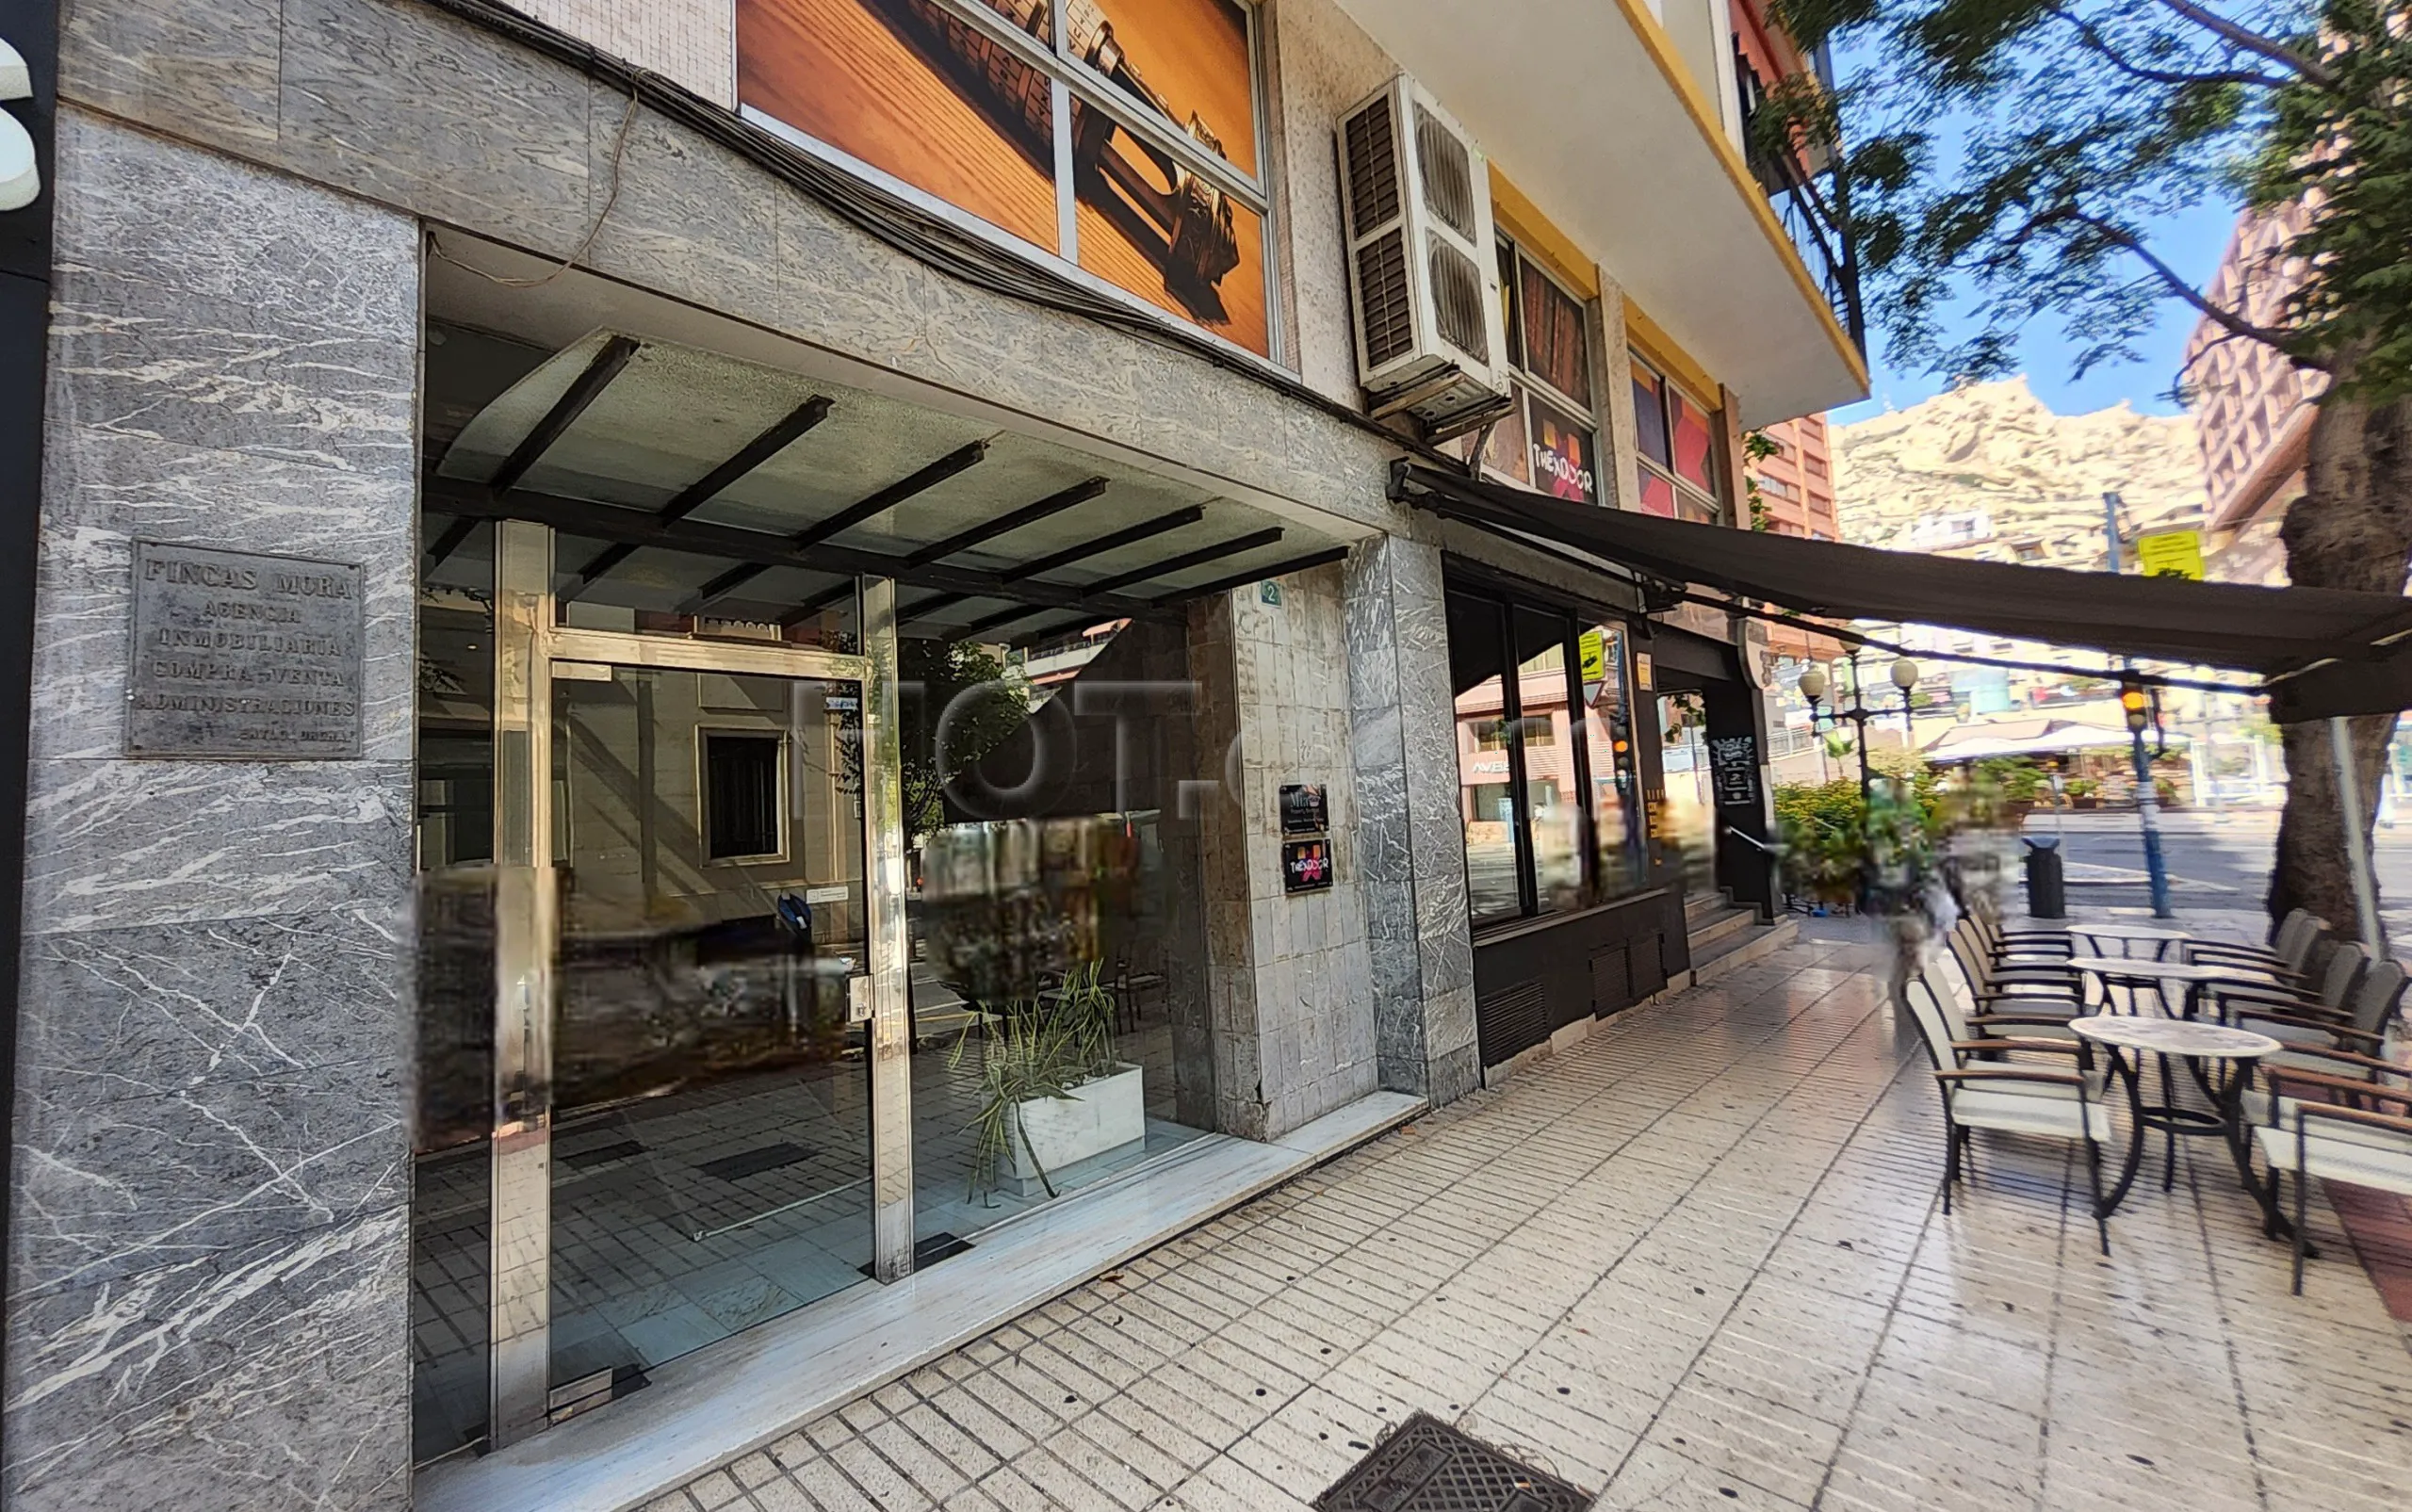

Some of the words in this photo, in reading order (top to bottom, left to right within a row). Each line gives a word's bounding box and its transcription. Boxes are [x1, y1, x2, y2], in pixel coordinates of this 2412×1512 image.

[144, 558, 258, 591] FINCAS
[273, 572, 353, 600] MURA
[1267, 584, 1276, 602] 2
[202, 599, 302, 625] AGENCIA
[157, 627, 343, 658] INMOBILIARIA
[140, 693, 356, 718] ADMINISTRACIONES
